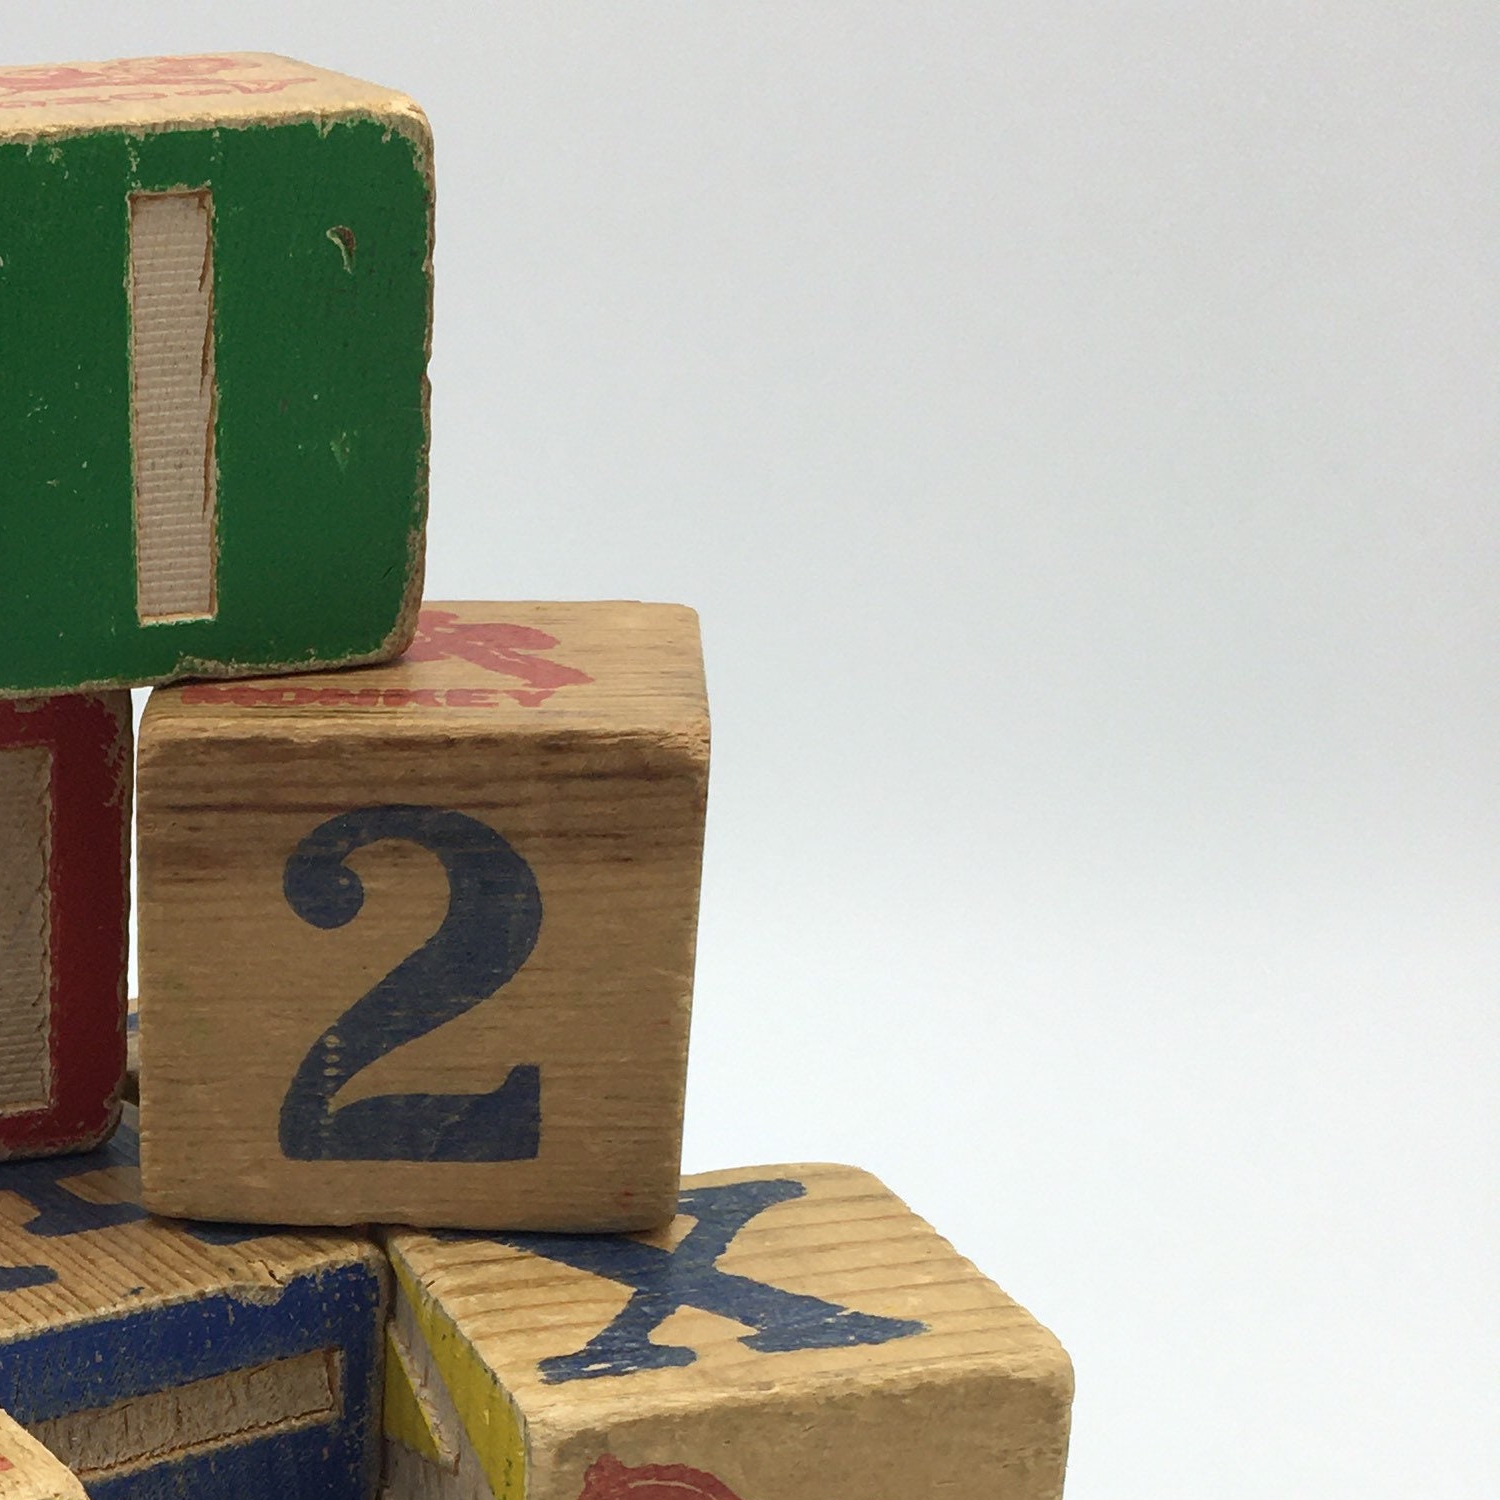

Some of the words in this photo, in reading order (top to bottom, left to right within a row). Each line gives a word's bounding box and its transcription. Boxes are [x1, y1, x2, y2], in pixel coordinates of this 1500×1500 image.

[181, 686, 555, 708] MONKEY
[278, 804, 543, 1162] 2
[435, 1178, 933, 1385] X
